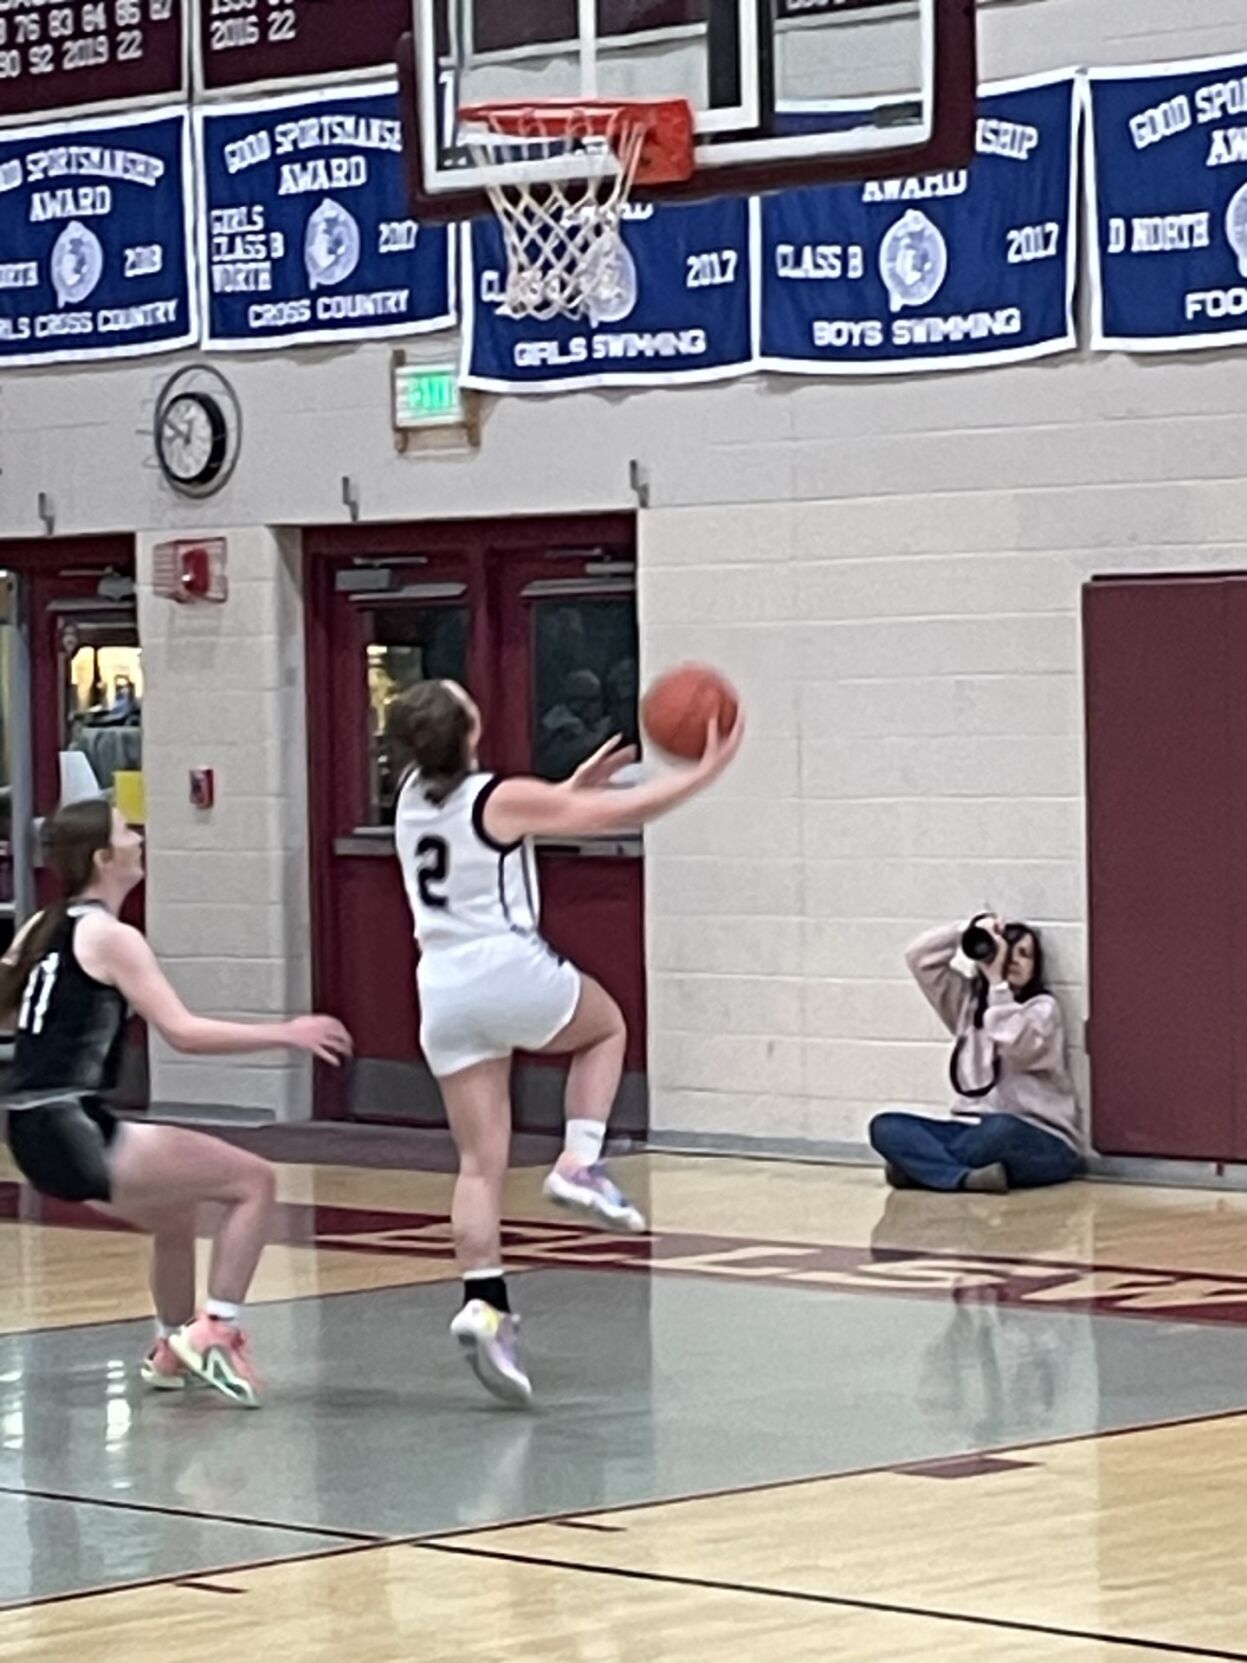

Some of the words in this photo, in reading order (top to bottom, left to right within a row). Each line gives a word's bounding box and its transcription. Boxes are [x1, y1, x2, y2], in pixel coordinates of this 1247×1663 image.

[267, 8, 296, 41] 22
[116, 29, 143, 60] 22
[1129, 94, 1192, 149] GOOD
[225, 130, 271, 174] GOOD
[278, 155, 367, 195] AWARD
[30, 185, 111, 222] AWARD
[210, 205, 264, 234] GIRLS
[212, 234, 267, 262] CLASS
[1006, 222, 1059, 263] 2017
[1131, 212, 1209, 252] NORTH
[212, 261, 272, 293] NORTH
[686, 250, 737, 288] 2017
[776, 244, 842, 279] CLASS
[848, 246, 863, 279] B
[34, 312, 93, 338] CROSS
[97, 299, 178, 332] COUNTRY
[249, 299, 311, 328] CROSS
[317, 289, 409, 320] COUNTRY
[513, 336, 588, 367] GIRLS
[813, 320, 883, 346] BOYS
[414, 834, 450, 909] 2
[18, 952, 59, 1034] 11
